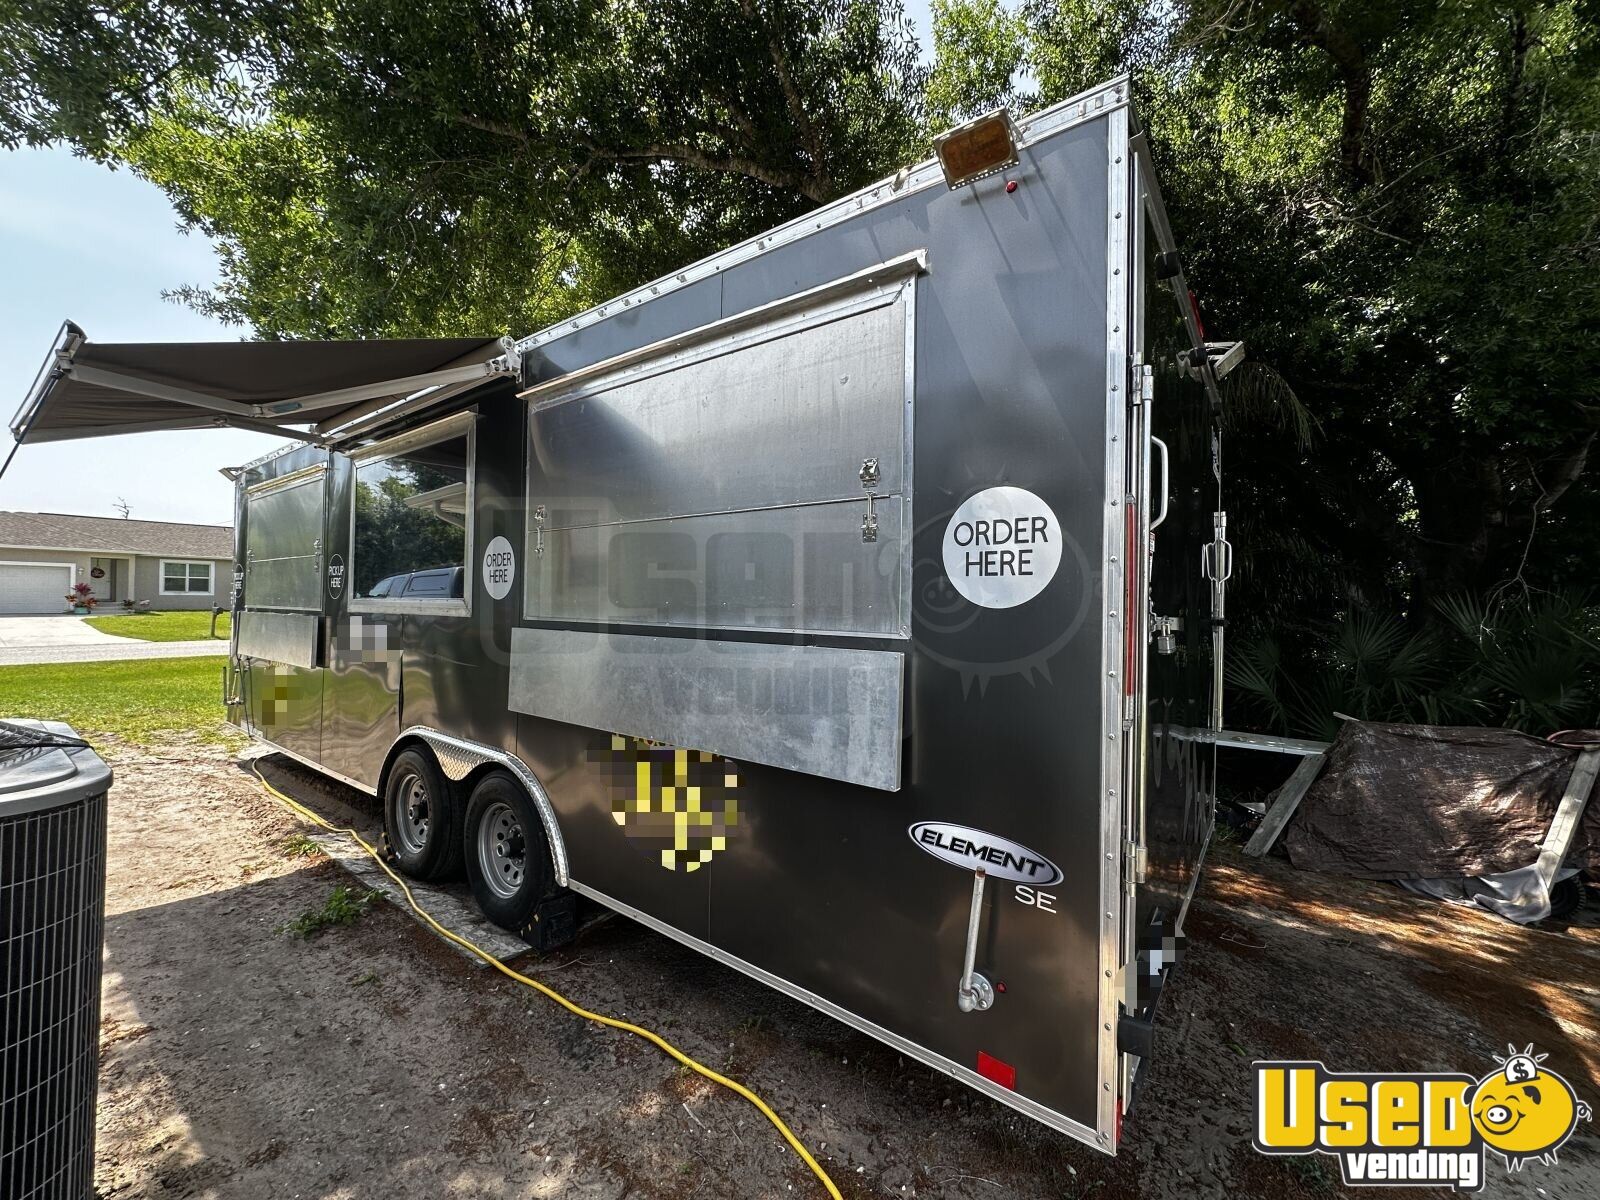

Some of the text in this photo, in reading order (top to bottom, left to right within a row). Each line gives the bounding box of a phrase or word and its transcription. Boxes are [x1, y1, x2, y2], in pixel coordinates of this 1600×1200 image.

[953, 516, 1048, 546] ORDER
[486, 552, 511, 567] ORDER
[965, 549, 1033, 576] HERE
[489, 569, 508, 583] HERE
[920, 828, 1045, 876] ELEMENT
[1014, 884, 1057, 914] SE
